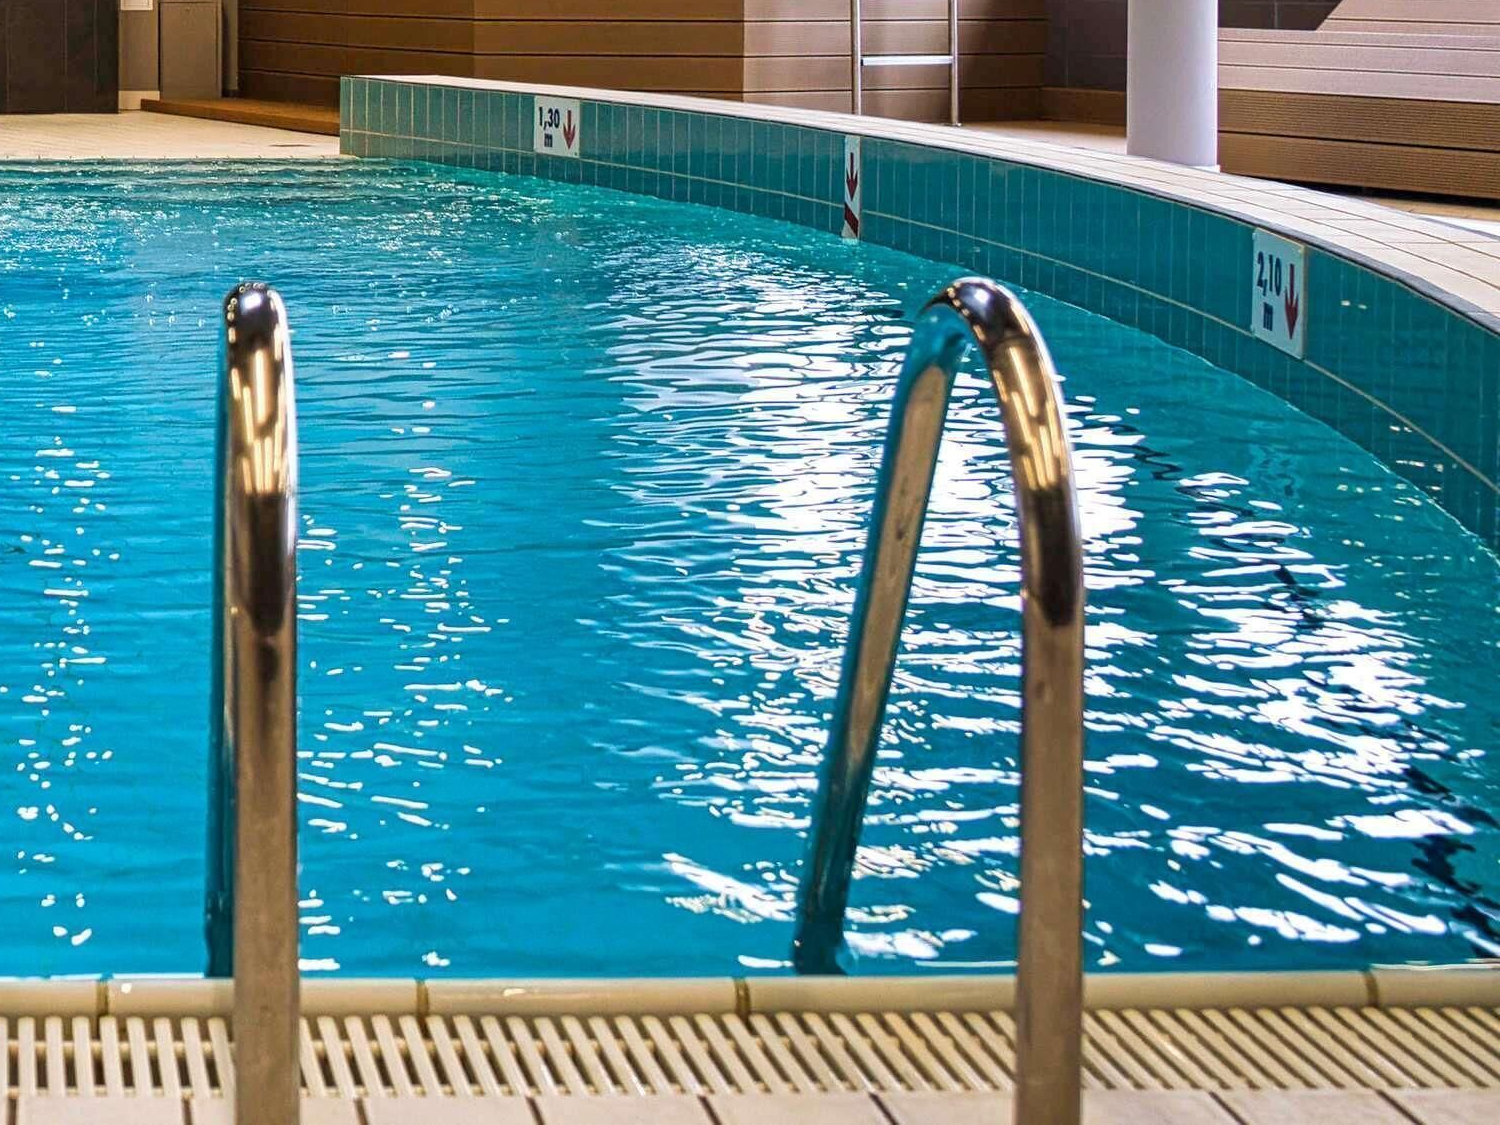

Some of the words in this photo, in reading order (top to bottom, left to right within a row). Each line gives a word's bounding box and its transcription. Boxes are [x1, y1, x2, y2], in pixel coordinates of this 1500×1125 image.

[539, 106, 560, 130] 1,30
[544, 133, 553, 148] m
[1257, 251, 1282, 296] 2,10
